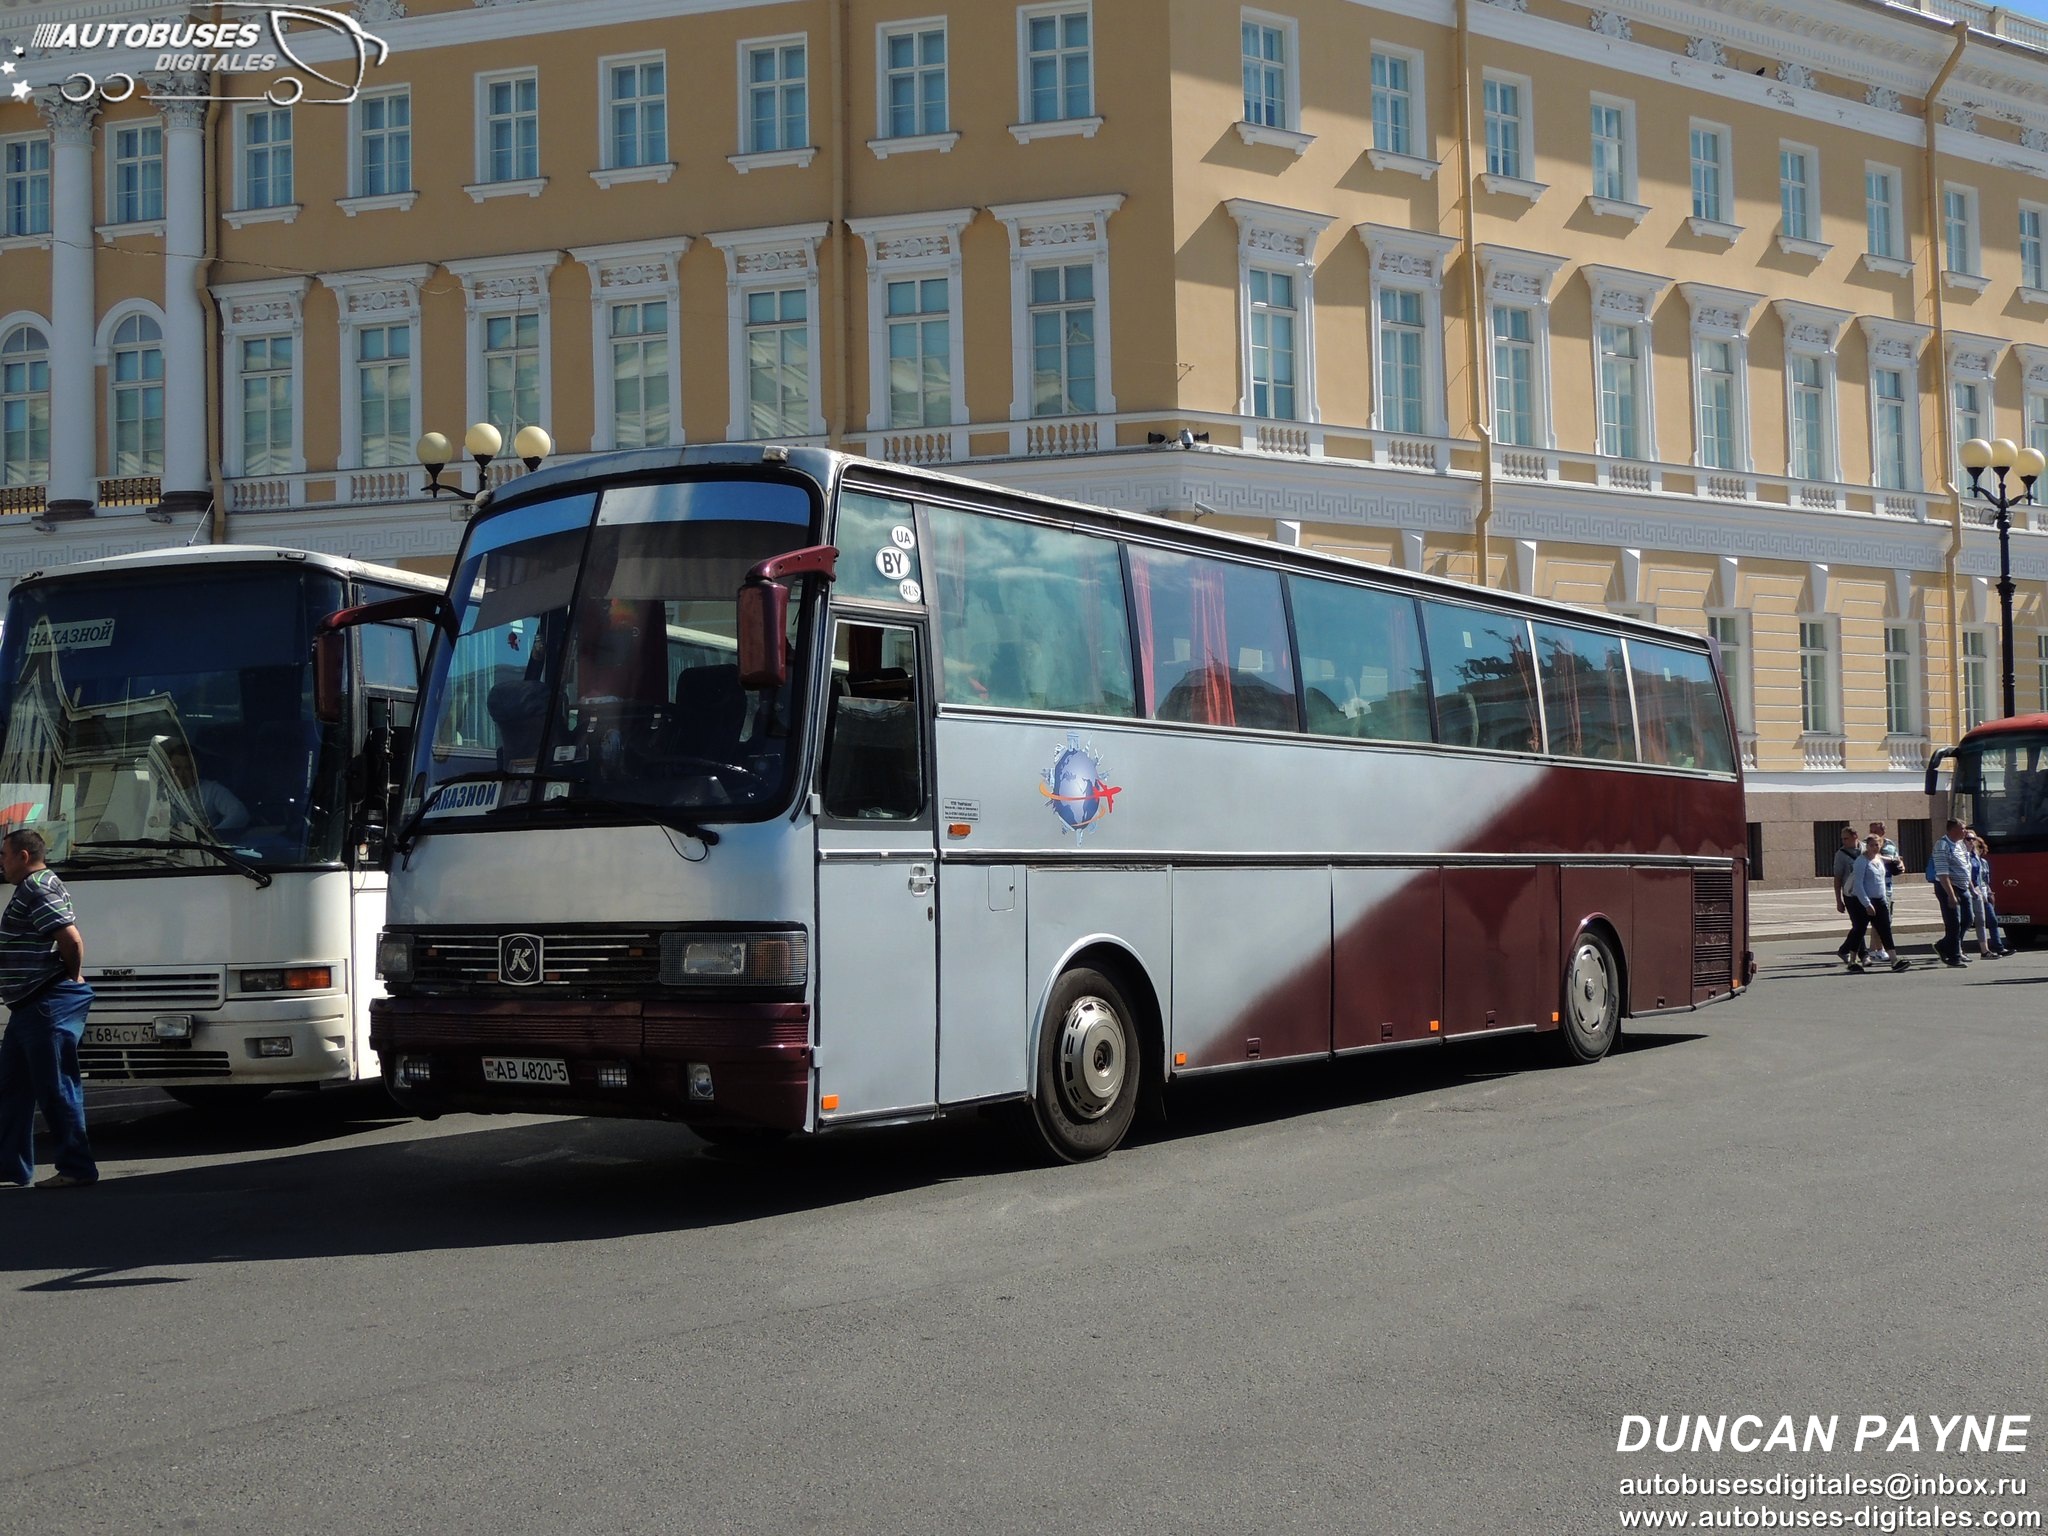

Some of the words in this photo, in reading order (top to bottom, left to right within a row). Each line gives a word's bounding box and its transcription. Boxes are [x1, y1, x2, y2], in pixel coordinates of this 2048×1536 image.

[896, 530, 911, 545] UA
[882, 552, 901, 574] BY
[902, 584, 919, 597] RUS
[28, 620, 113, 647] ЗАКАЗНОЙ
[427, 780, 497, 812] АКАЗНОЙ
[521, 1061, 567, 1081] 4820-5
